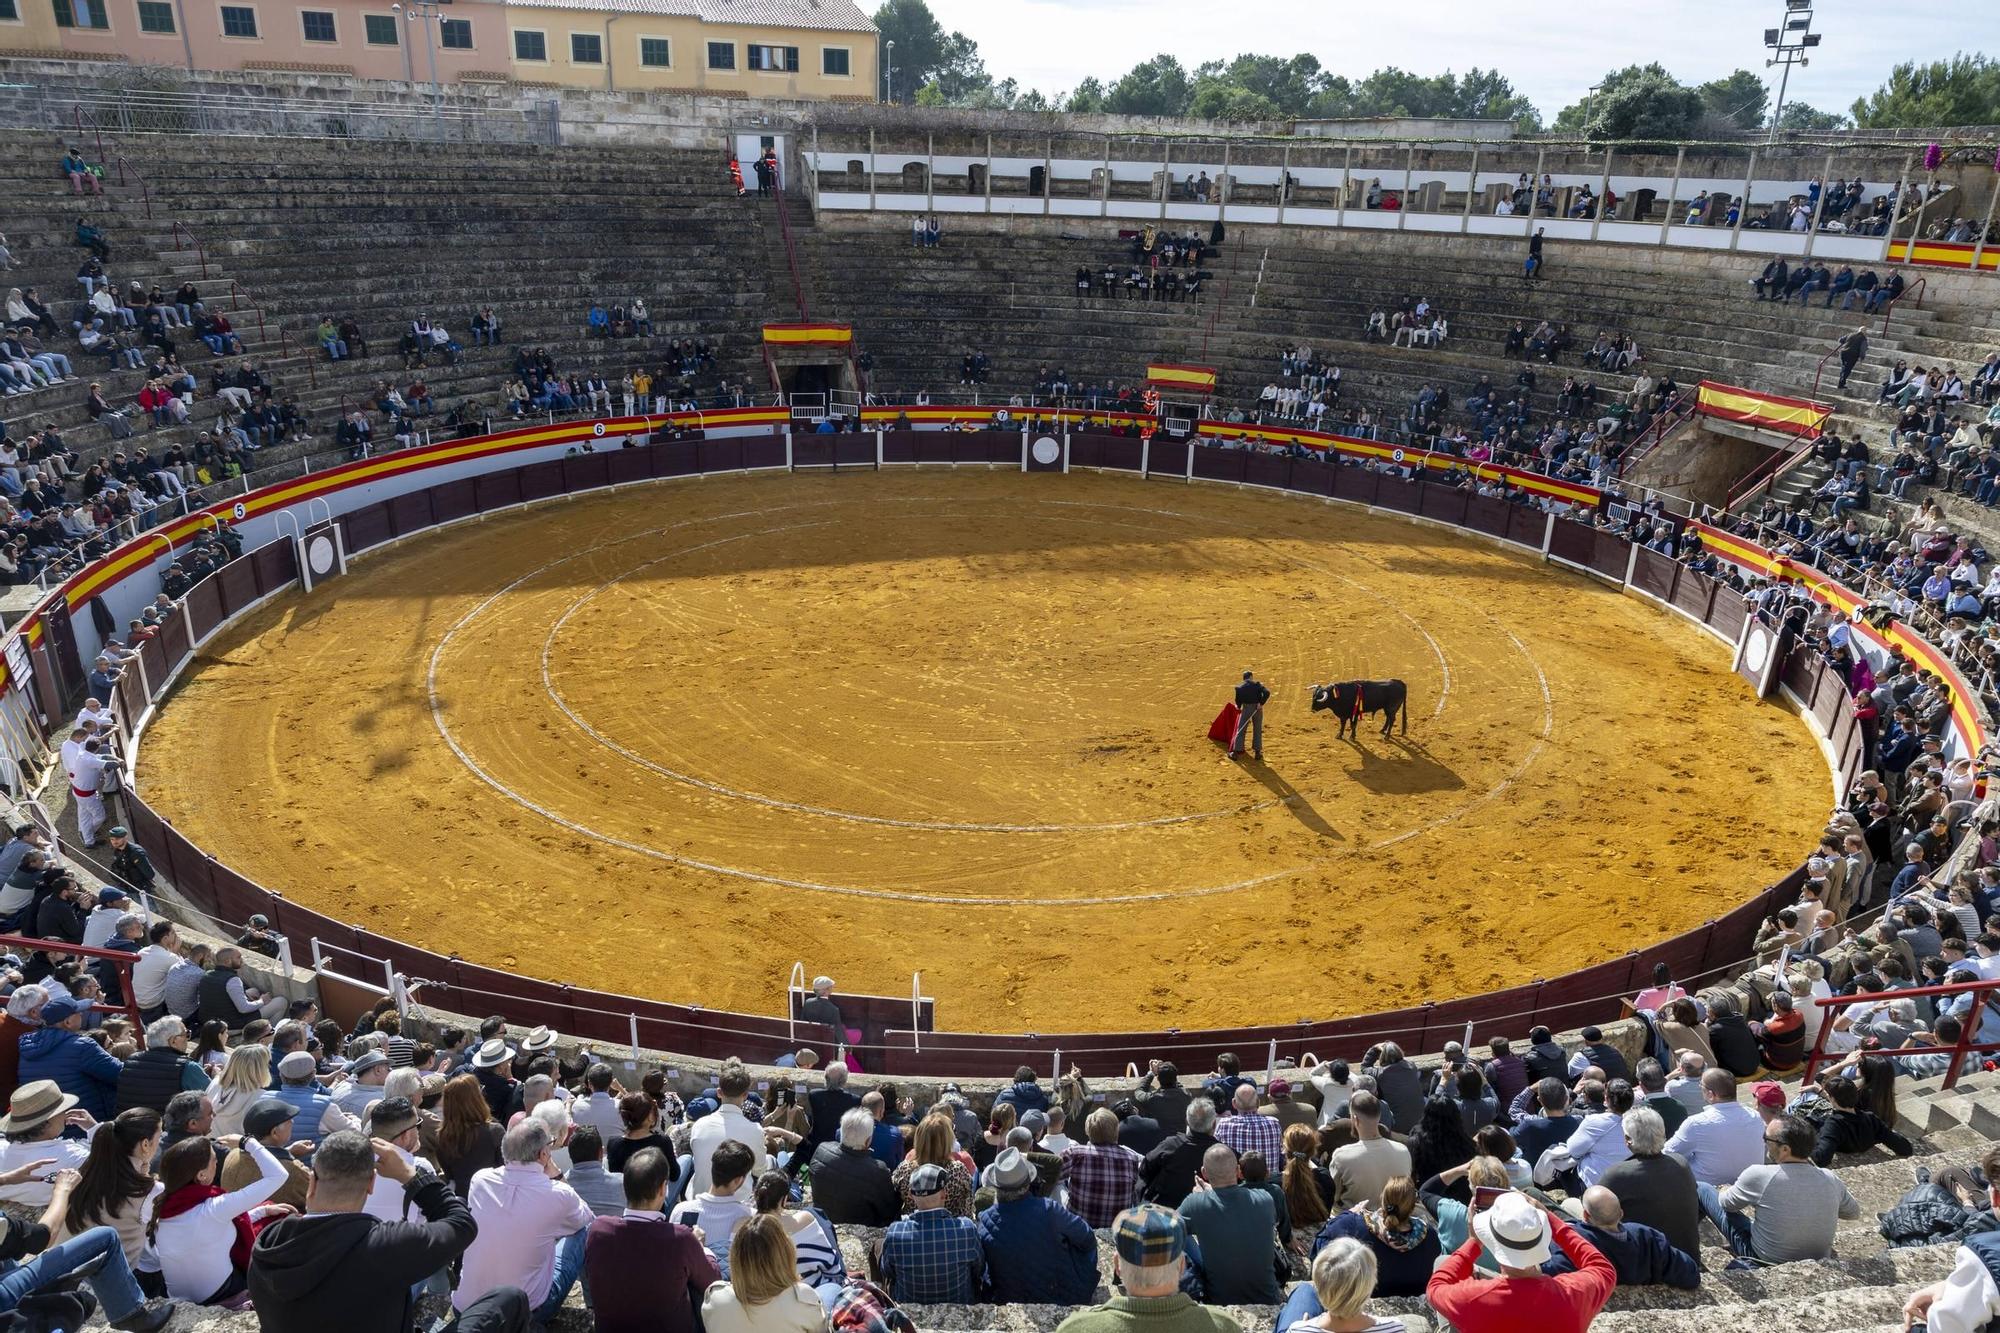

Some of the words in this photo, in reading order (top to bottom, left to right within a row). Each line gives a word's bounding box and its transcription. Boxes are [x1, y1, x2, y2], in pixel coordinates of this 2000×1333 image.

[1000, 411, 1006, 420] 7
[596, 424, 603, 435] 6
[1395, 450, 1402, 460] 8
[236, 504, 244, 517] 5
